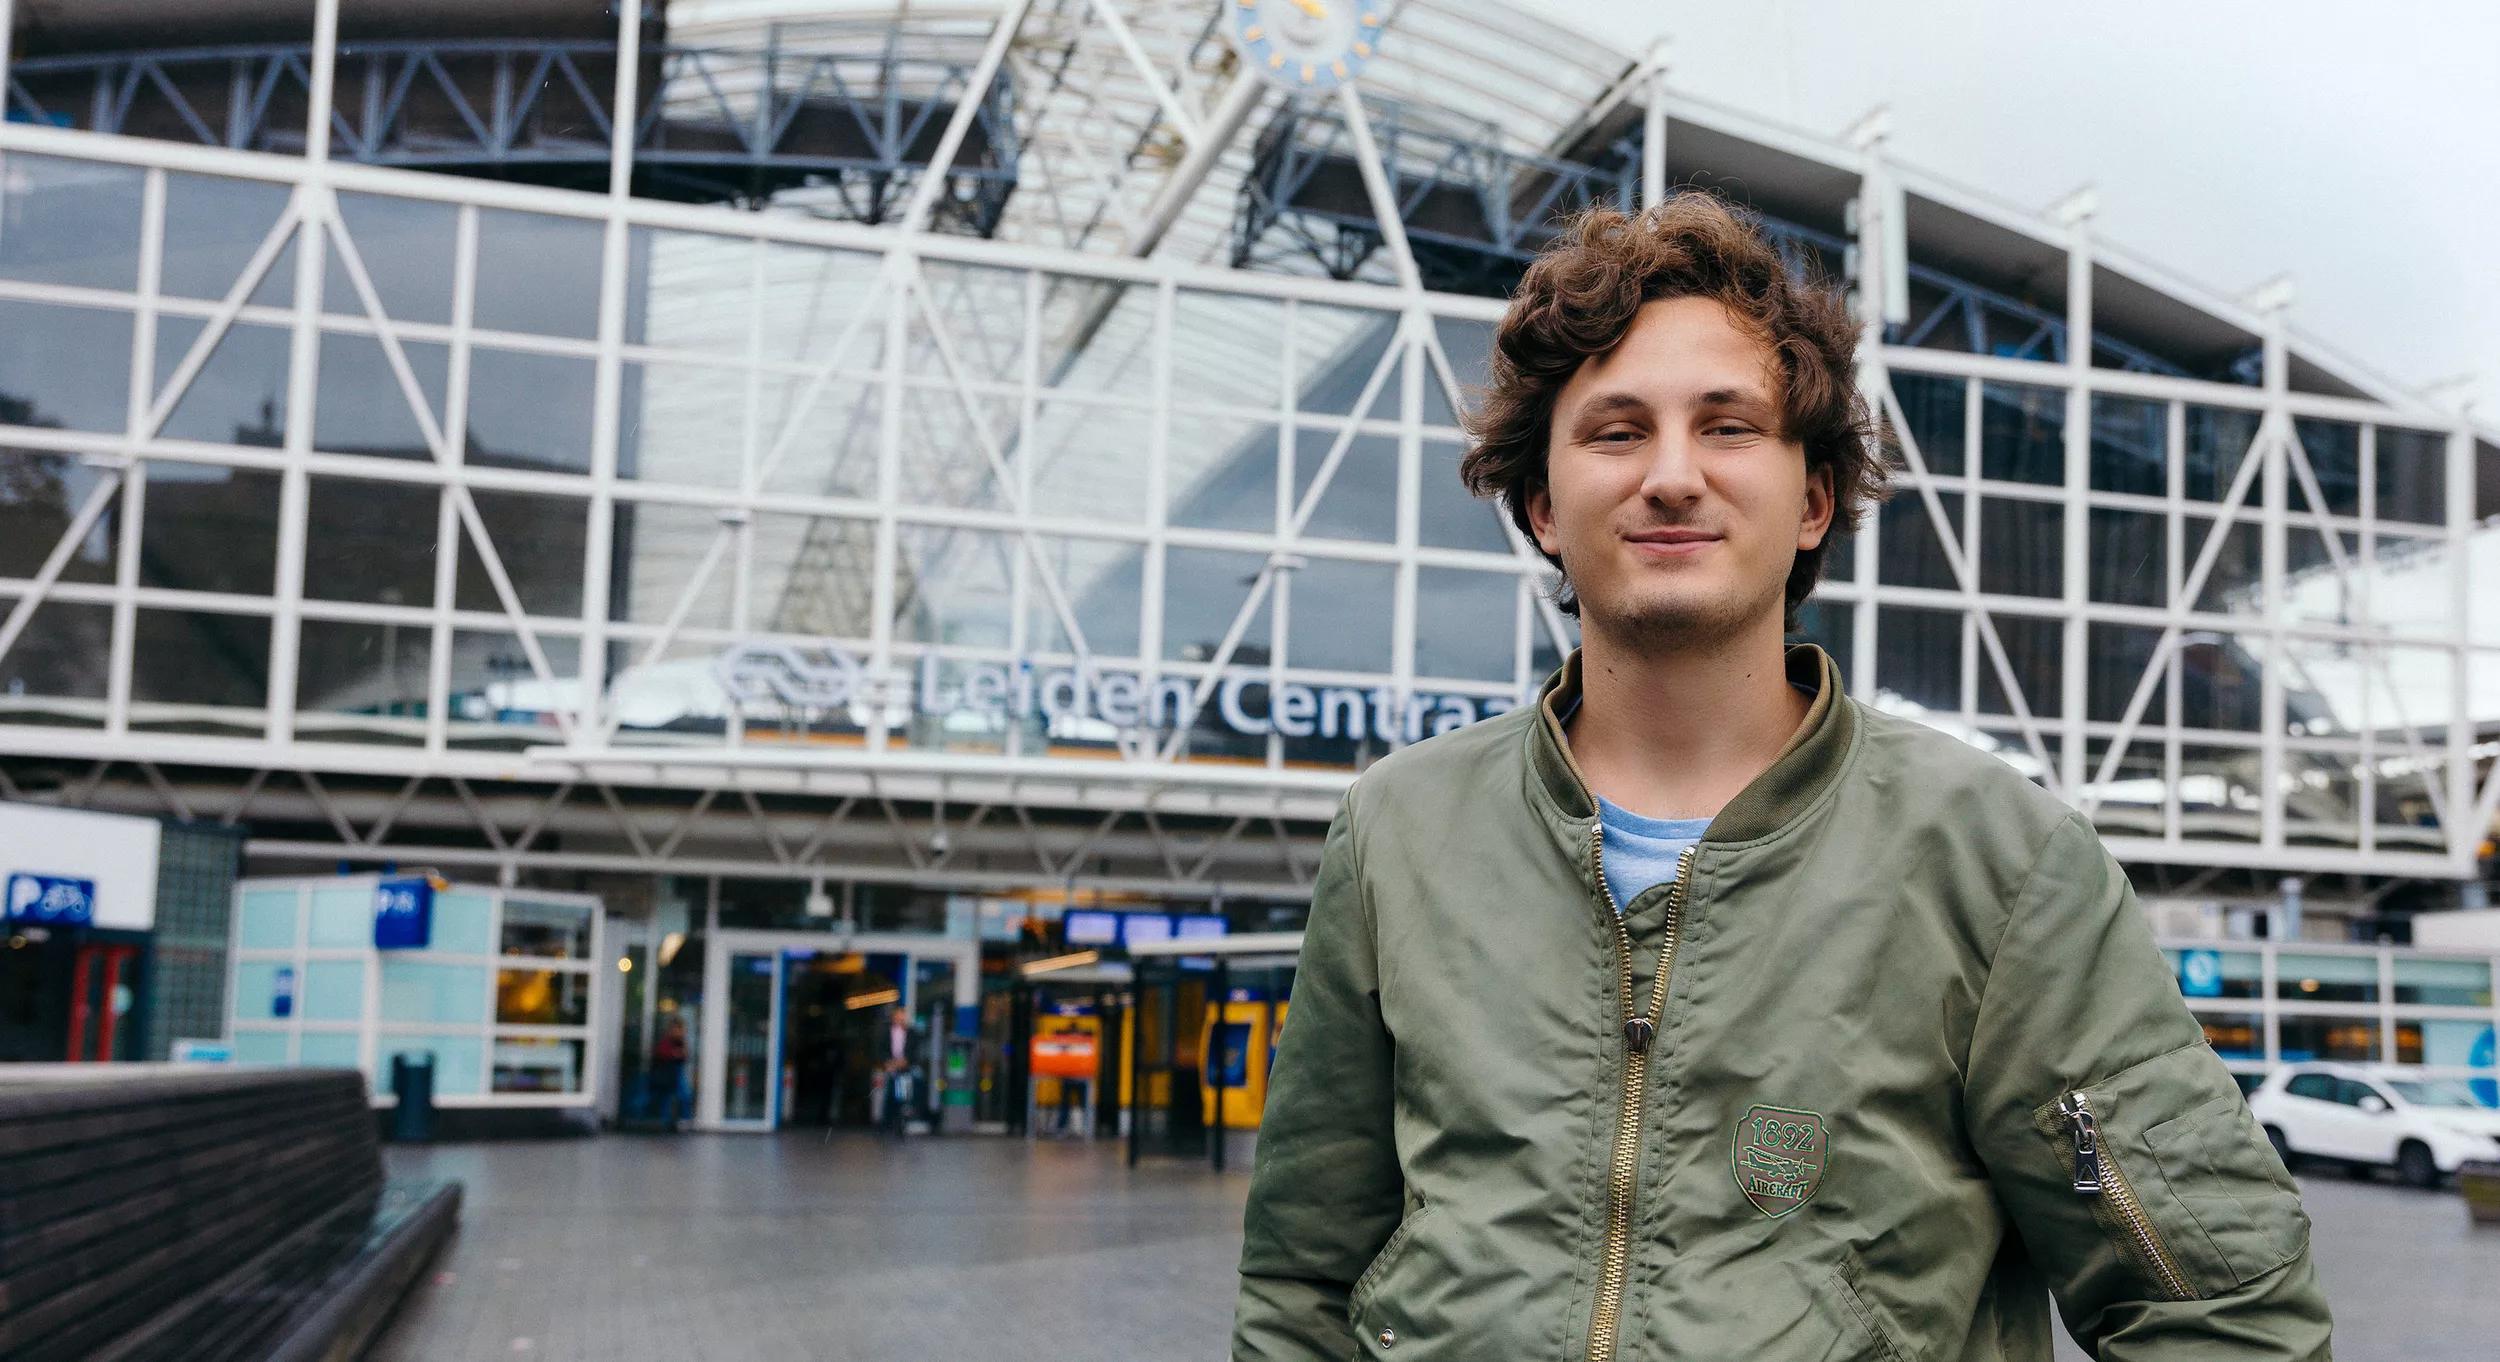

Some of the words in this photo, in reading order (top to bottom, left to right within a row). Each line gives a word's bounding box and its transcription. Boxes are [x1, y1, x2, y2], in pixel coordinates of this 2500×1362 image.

[919, 651, 1193, 729] Leiden
[1219, 670, 1542, 743] Centra
[12, 878, 42, 915] P
[1752, 1117, 1815, 1152] 1892
[1748, 1175, 1809, 1200] AIRCRAFT
